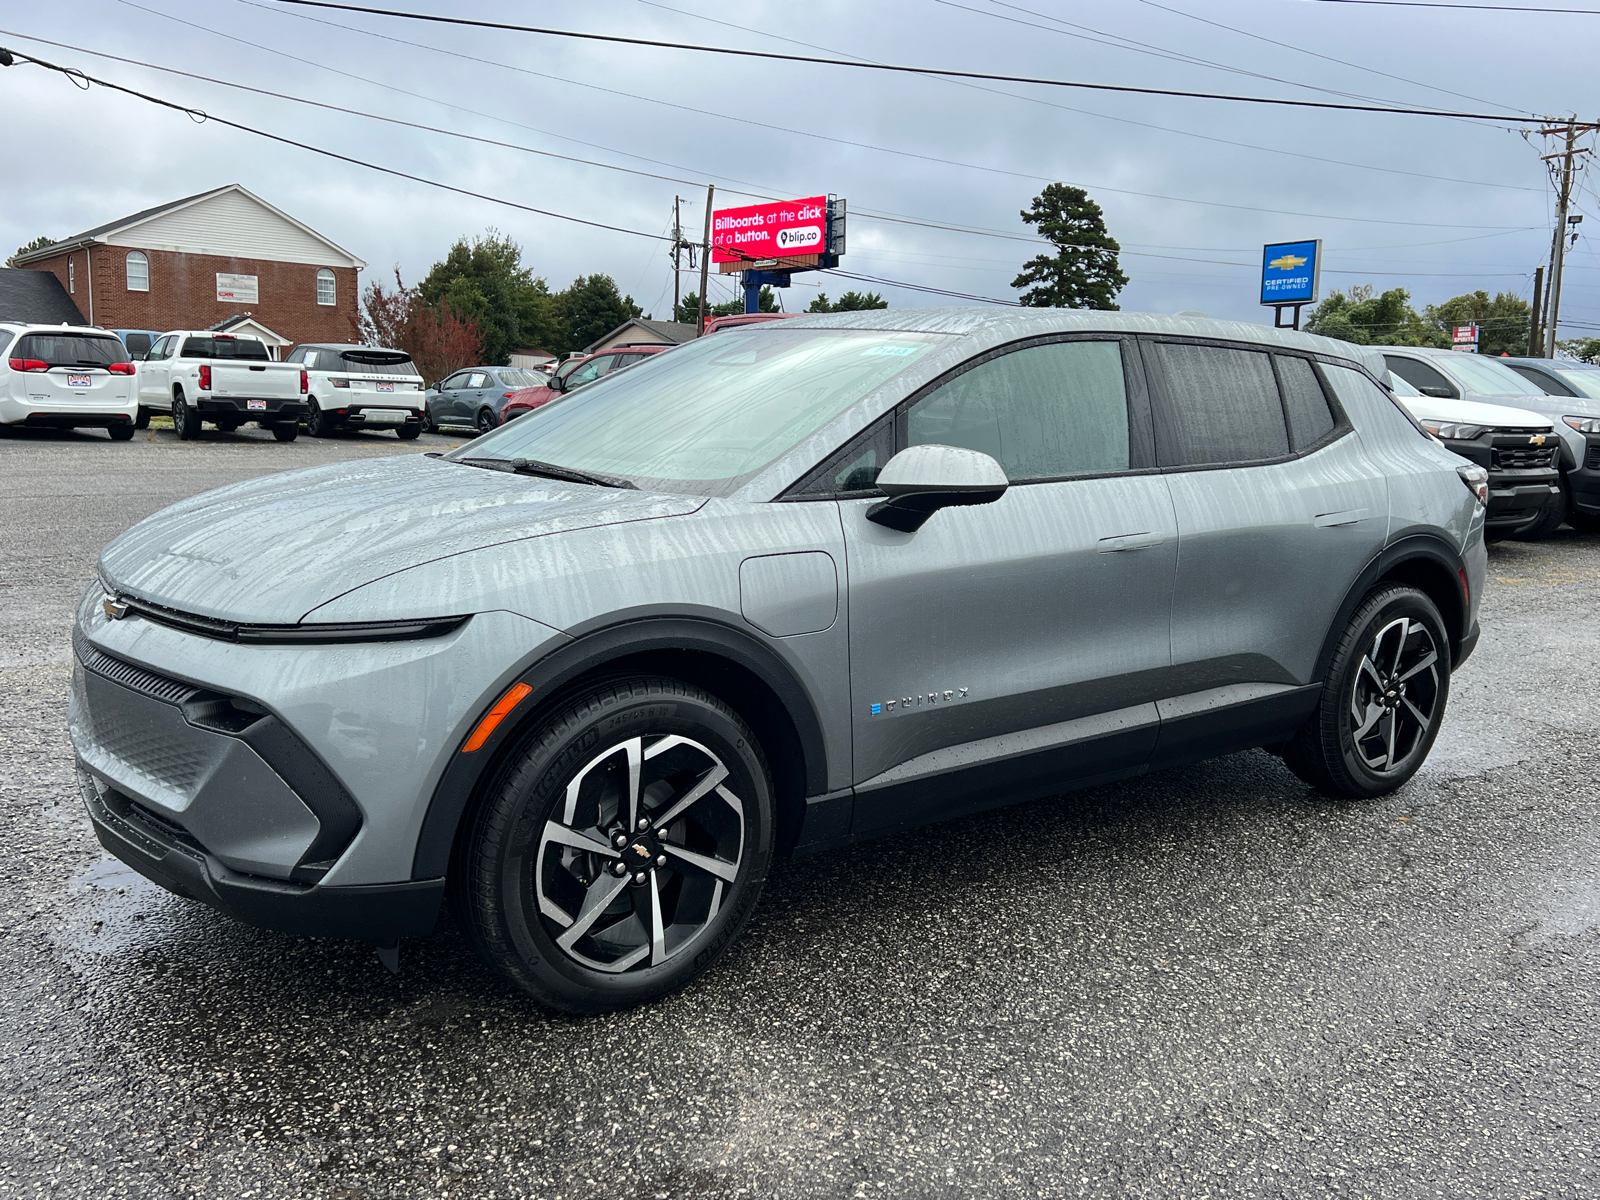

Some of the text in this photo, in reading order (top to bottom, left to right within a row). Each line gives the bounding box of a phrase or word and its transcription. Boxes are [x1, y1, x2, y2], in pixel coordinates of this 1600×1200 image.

[715, 205, 822, 230] Billboards at the click
[714, 230, 770, 246] of a button.
[789, 230, 817, 244] blip.co
[1265, 277, 1308, 286] CERTIFIED
[871, 687, 968, 716] EQUINOX
